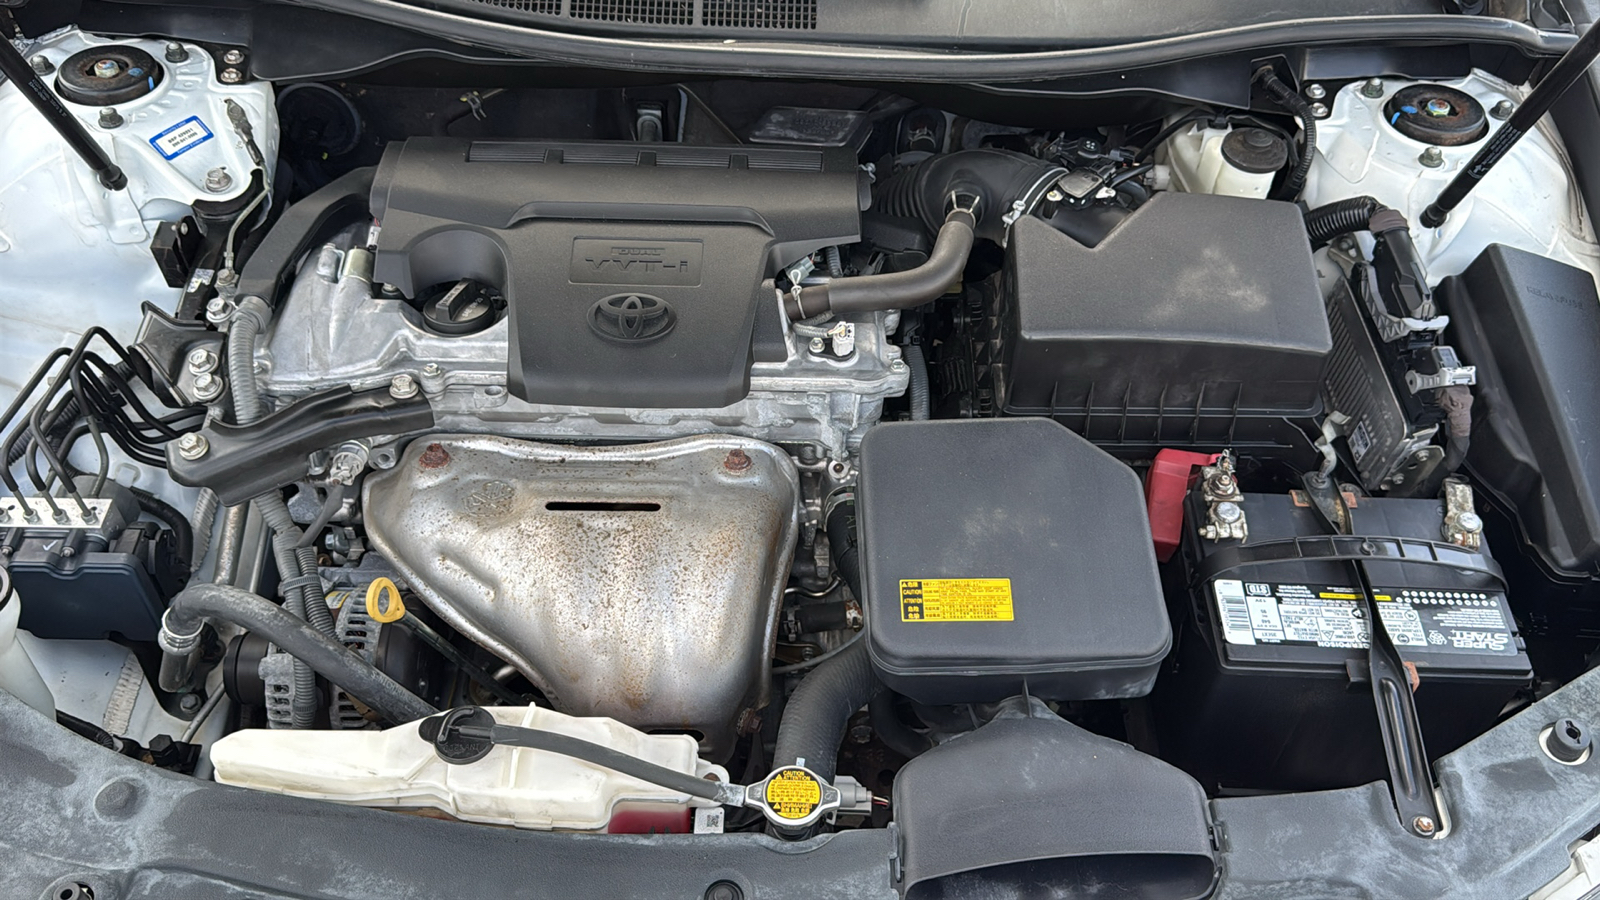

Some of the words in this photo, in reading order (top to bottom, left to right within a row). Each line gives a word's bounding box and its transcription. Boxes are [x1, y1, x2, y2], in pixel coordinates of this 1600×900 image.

[585, 258, 688, 273] VVT-i
[1451, 631, 1509, 644] START
[1317, 641, 1370, 649] GER/POISON
[1453, 639, 1505, 651] SUPER
